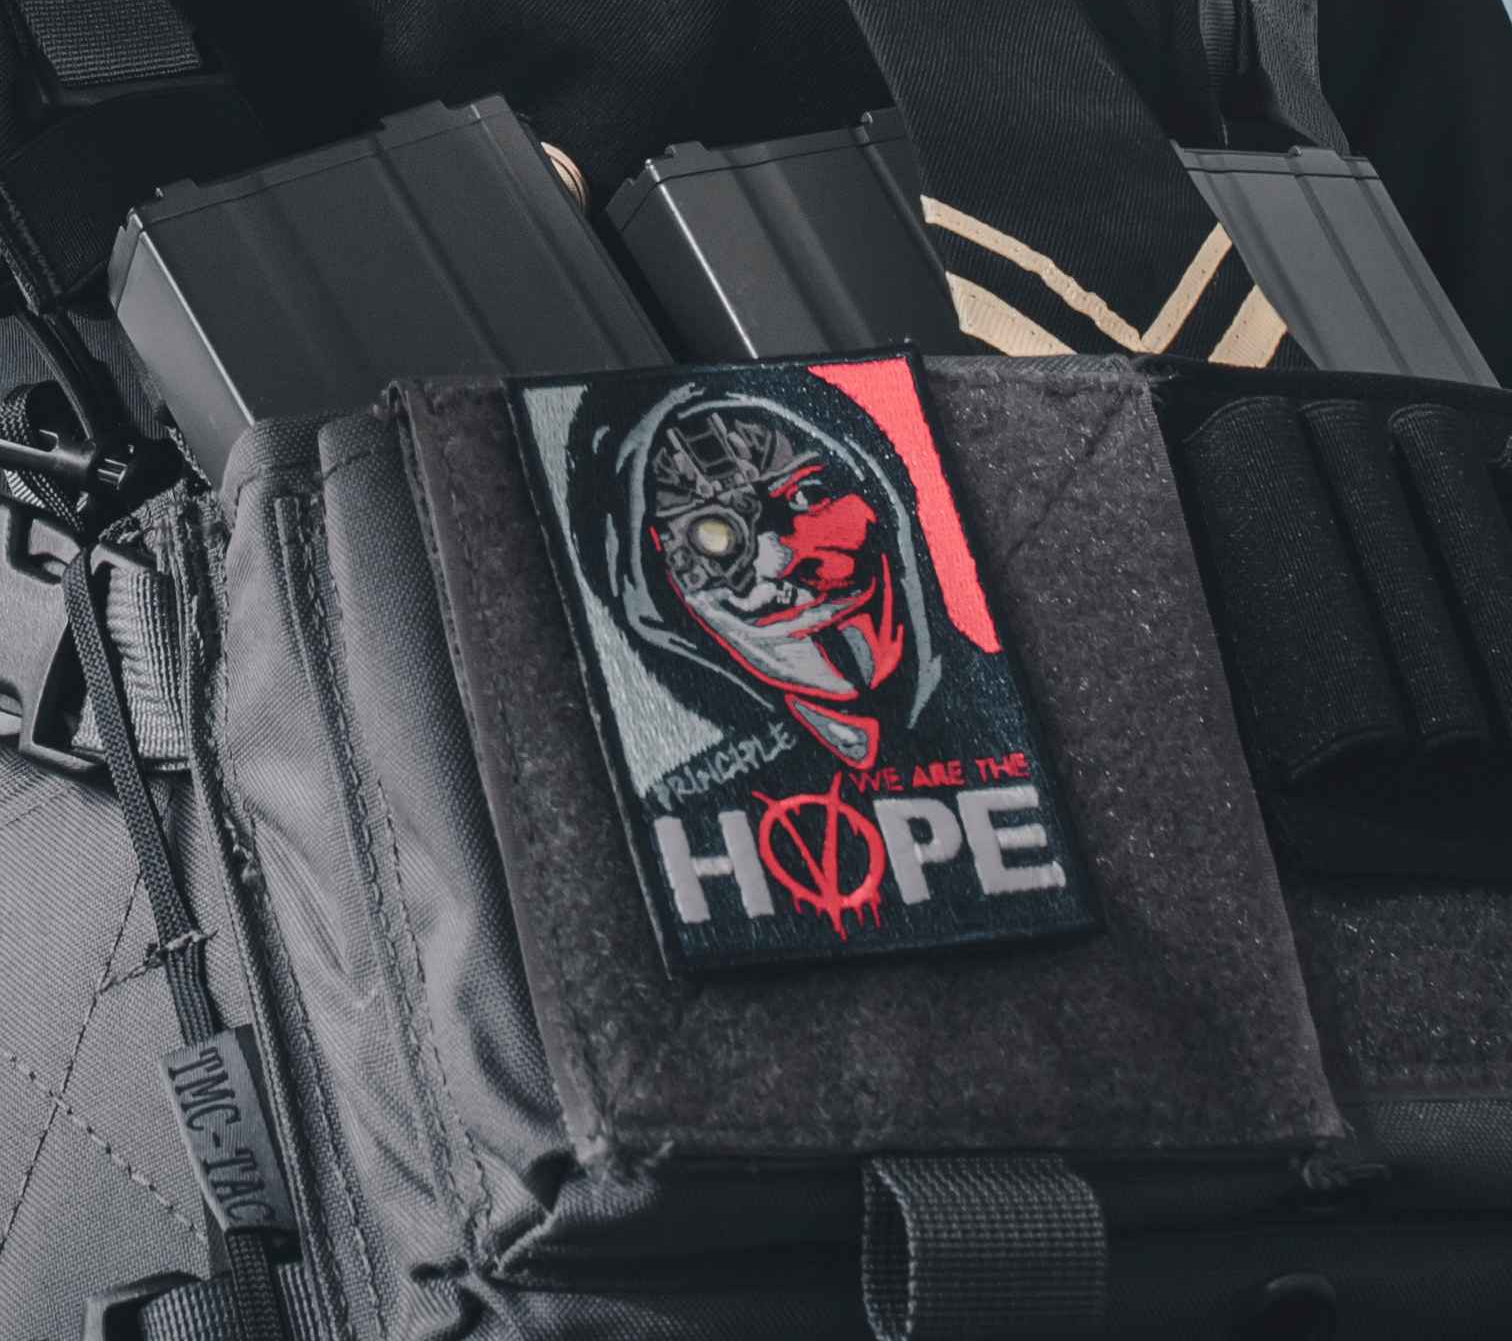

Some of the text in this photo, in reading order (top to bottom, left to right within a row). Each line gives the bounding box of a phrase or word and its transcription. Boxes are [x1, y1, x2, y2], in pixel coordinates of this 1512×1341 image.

[849, 752, 1030, 794] WE ARE THE
